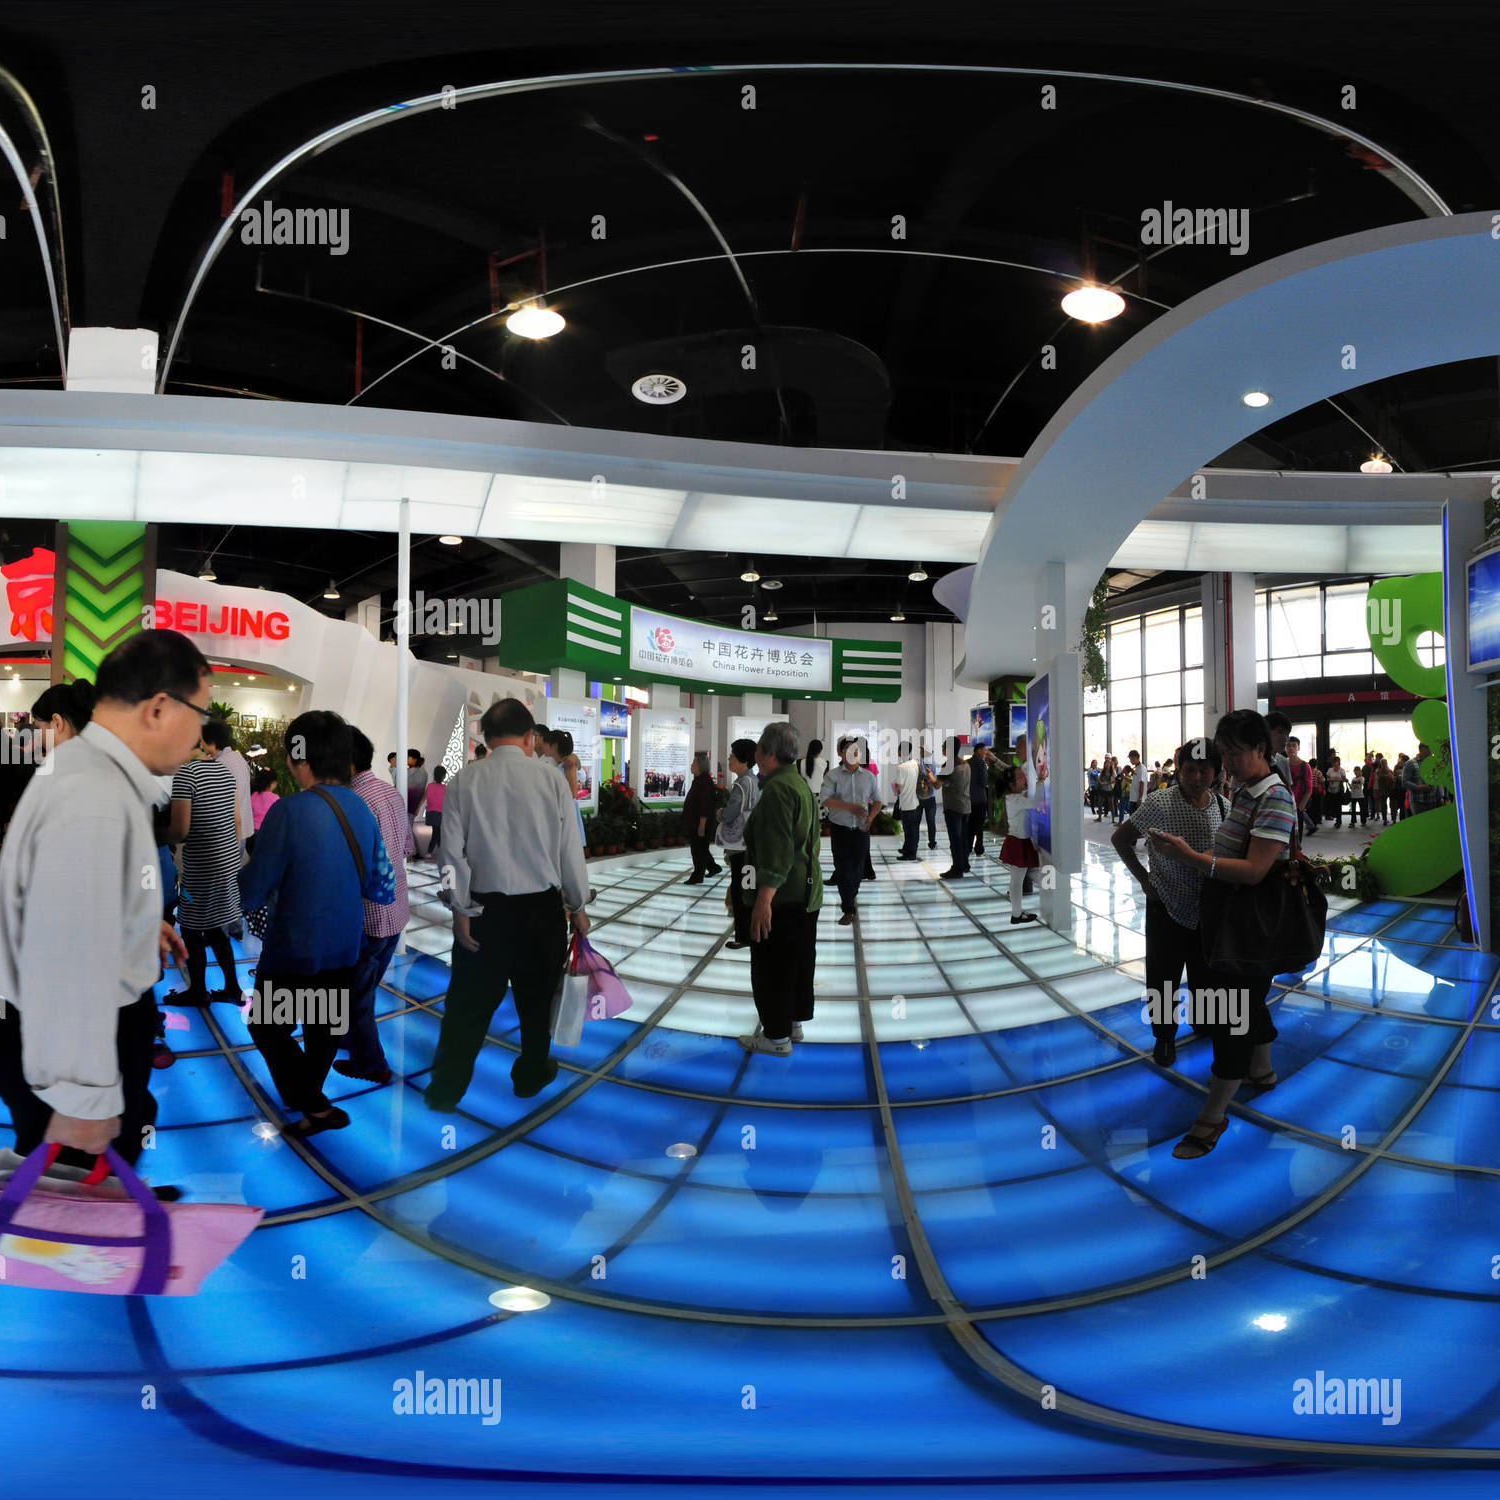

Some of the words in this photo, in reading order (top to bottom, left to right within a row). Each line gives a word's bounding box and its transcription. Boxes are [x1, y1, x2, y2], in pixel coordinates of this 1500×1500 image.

[155, 598, 290, 640] BEIJING
[703, 639, 814, 666] 中国花卉博览会
[712, 660, 736, 671] China
[738, 662, 764, 674] Flower
[766, 667, 809, 678] Exposition
